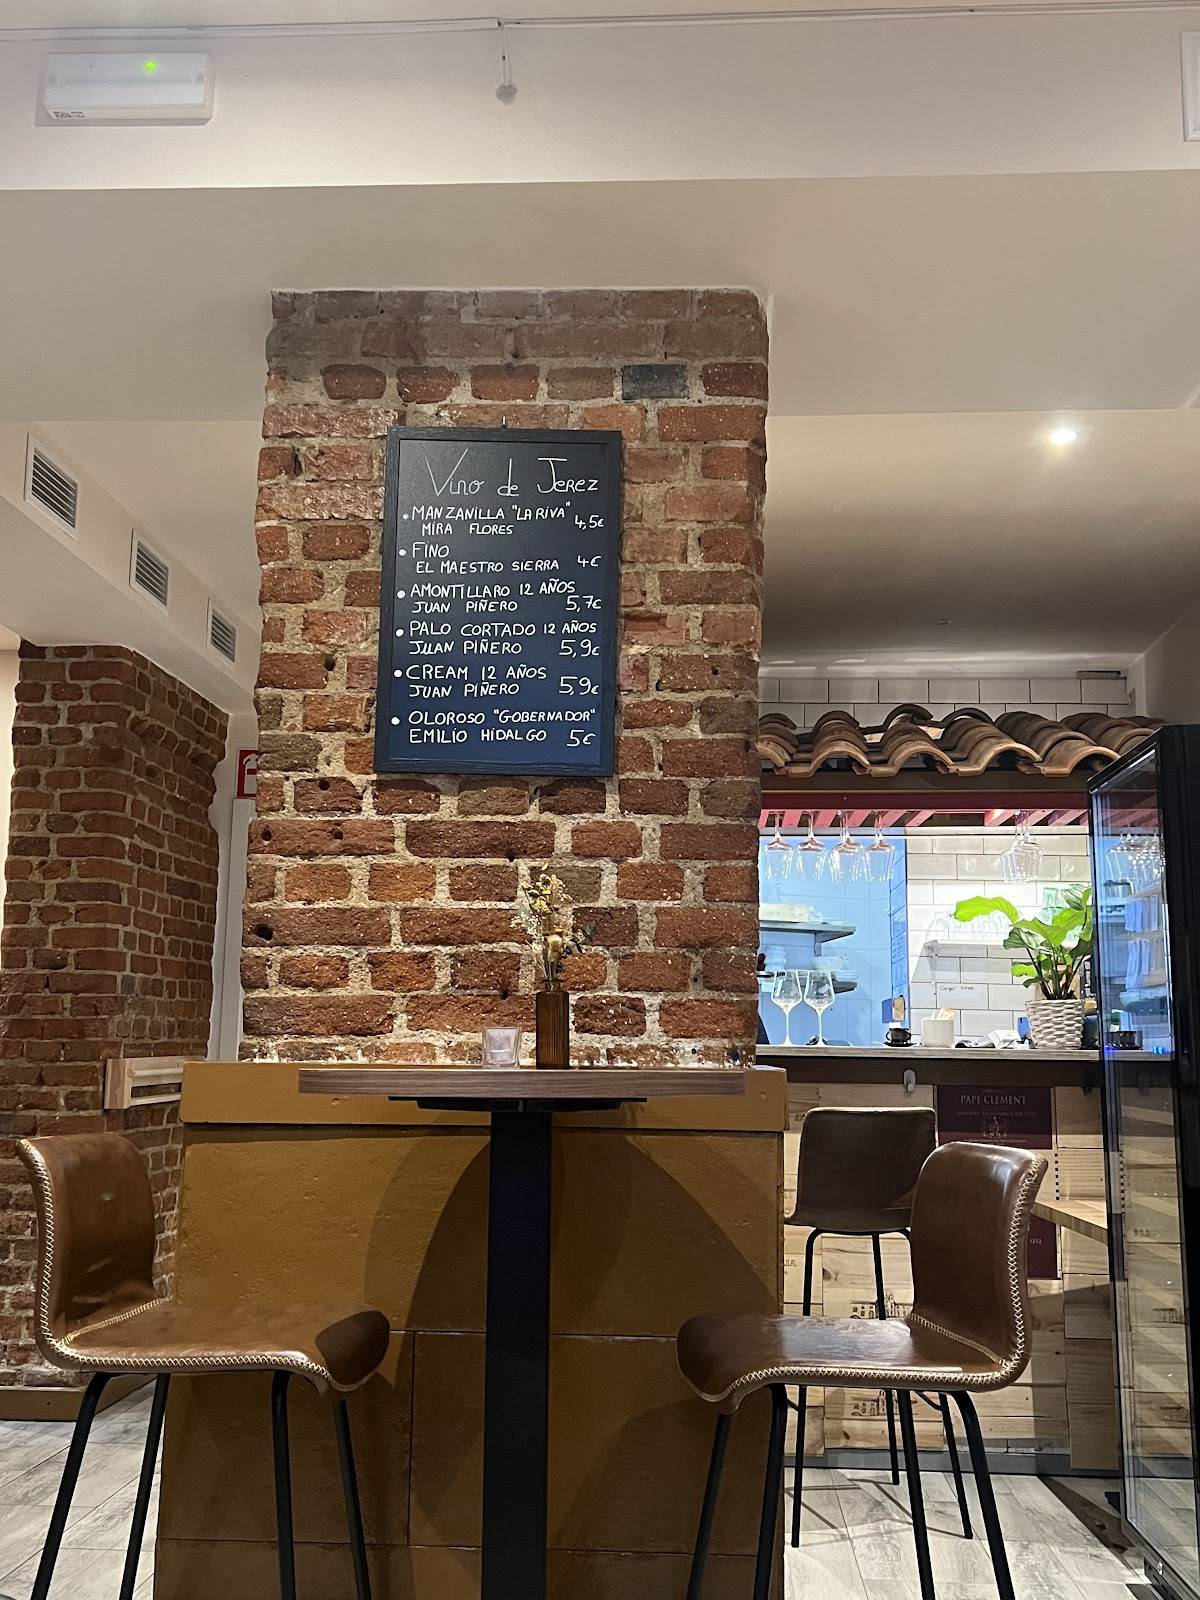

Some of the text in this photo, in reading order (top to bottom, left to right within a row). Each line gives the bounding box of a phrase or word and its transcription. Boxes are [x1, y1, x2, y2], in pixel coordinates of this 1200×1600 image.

[424, 448, 485, 497] Vino
[497, 458, 519, 496] de
[411, 505, 505, 521] MANZANILLA
[421, 521, 515, 537] MIRA FLORES
[412, 540, 450, 558] FINO
[416, 558, 560, 575] EL MAESTRO SIERRA
[577, 554, 602, 568] 4€
[519, 583, 535, 596] 12
[539, 577, 576, 595] AÑOS
[411, 595, 602, 614] JUAN PIÑERO 5,7€
[409, 619, 597, 638] PALO CORTADO 12 AÑOS
[408, 638, 600, 658] JUAN PIÑERO 5,9€
[405, 663, 547, 681] CREAM 12 AÑOS
[408, 675, 600, 699] JUAN PIÑERO 5,9€
[408, 707, 596, 726] OLOROSO "GOBERNADOR"
[409, 727, 597, 747] EMILIO HIDALGO 5€
[983, 1095, 1027, 1106] CLEMENT
